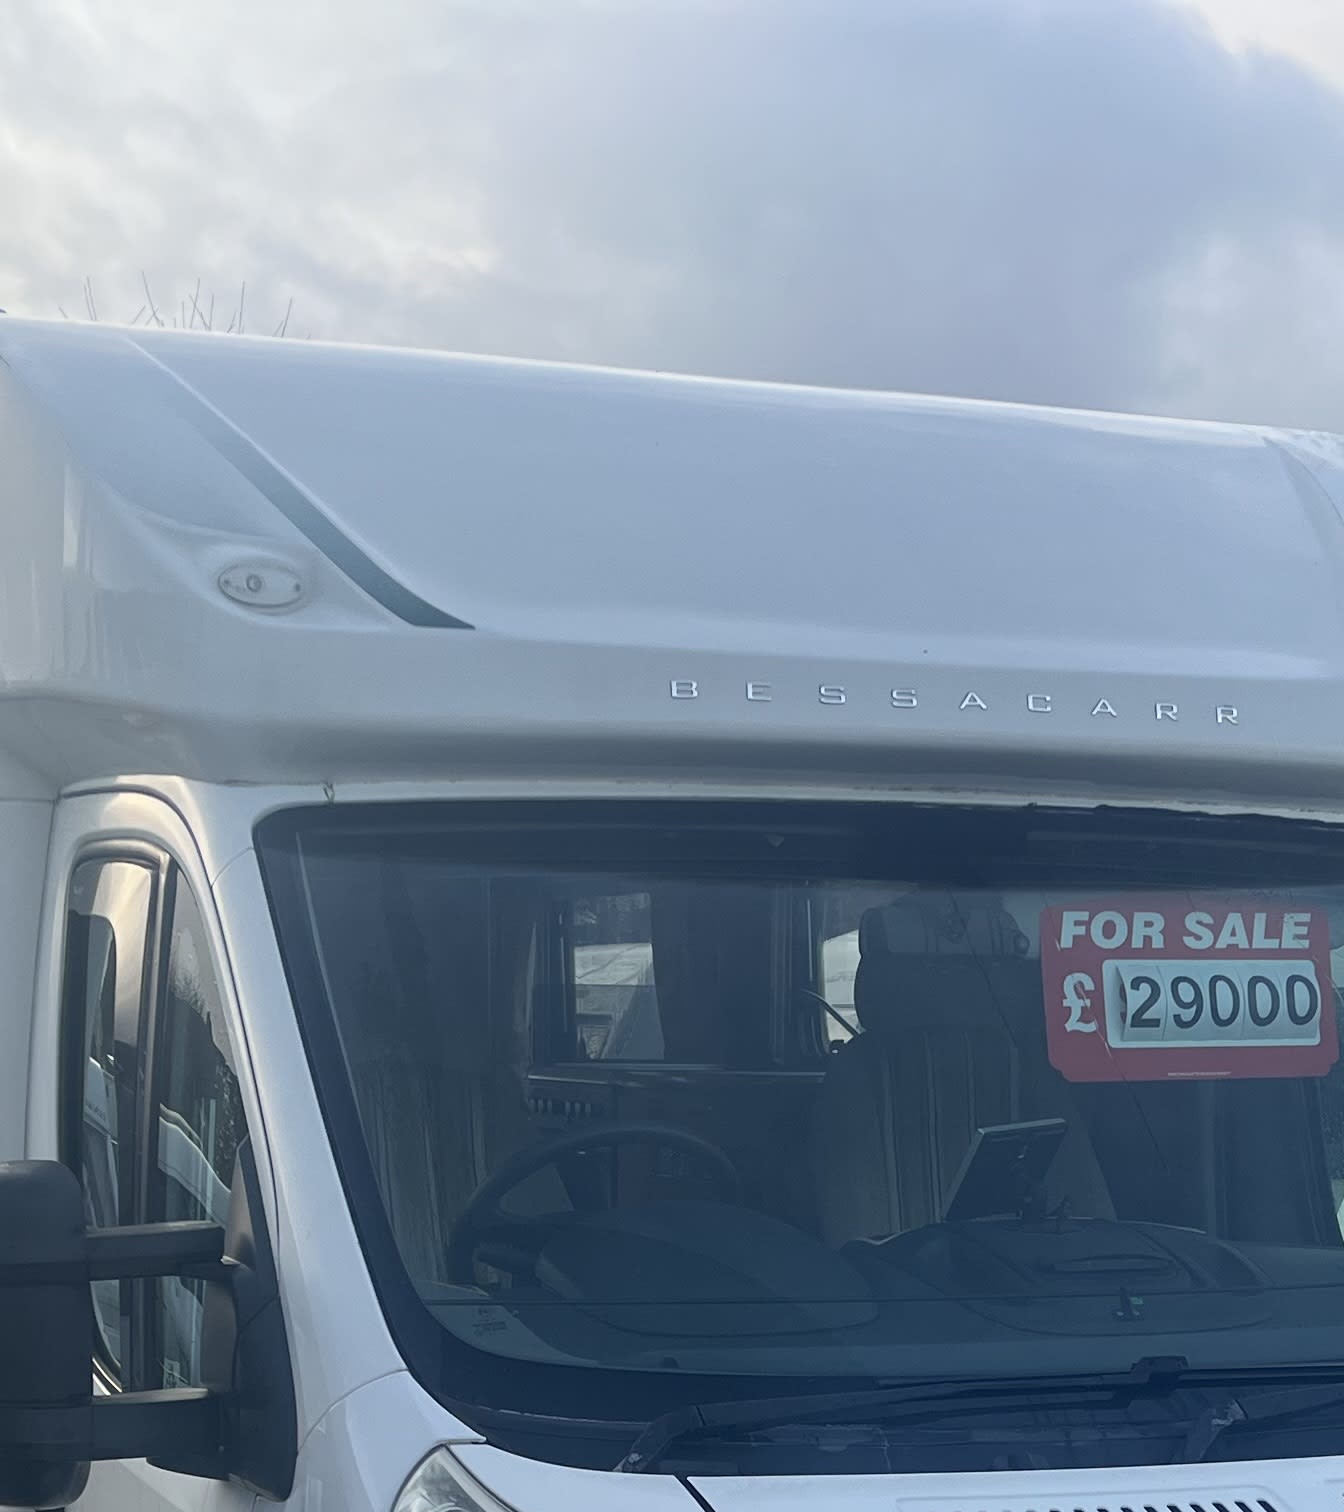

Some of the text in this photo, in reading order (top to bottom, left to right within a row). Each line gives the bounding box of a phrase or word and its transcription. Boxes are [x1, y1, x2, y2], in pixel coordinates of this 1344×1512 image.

[669, 678, 1240, 725] BESSACARR
[1060, 911, 1312, 950] FOR SALE
[1062, 971, 1320, 1033] £ 29000
